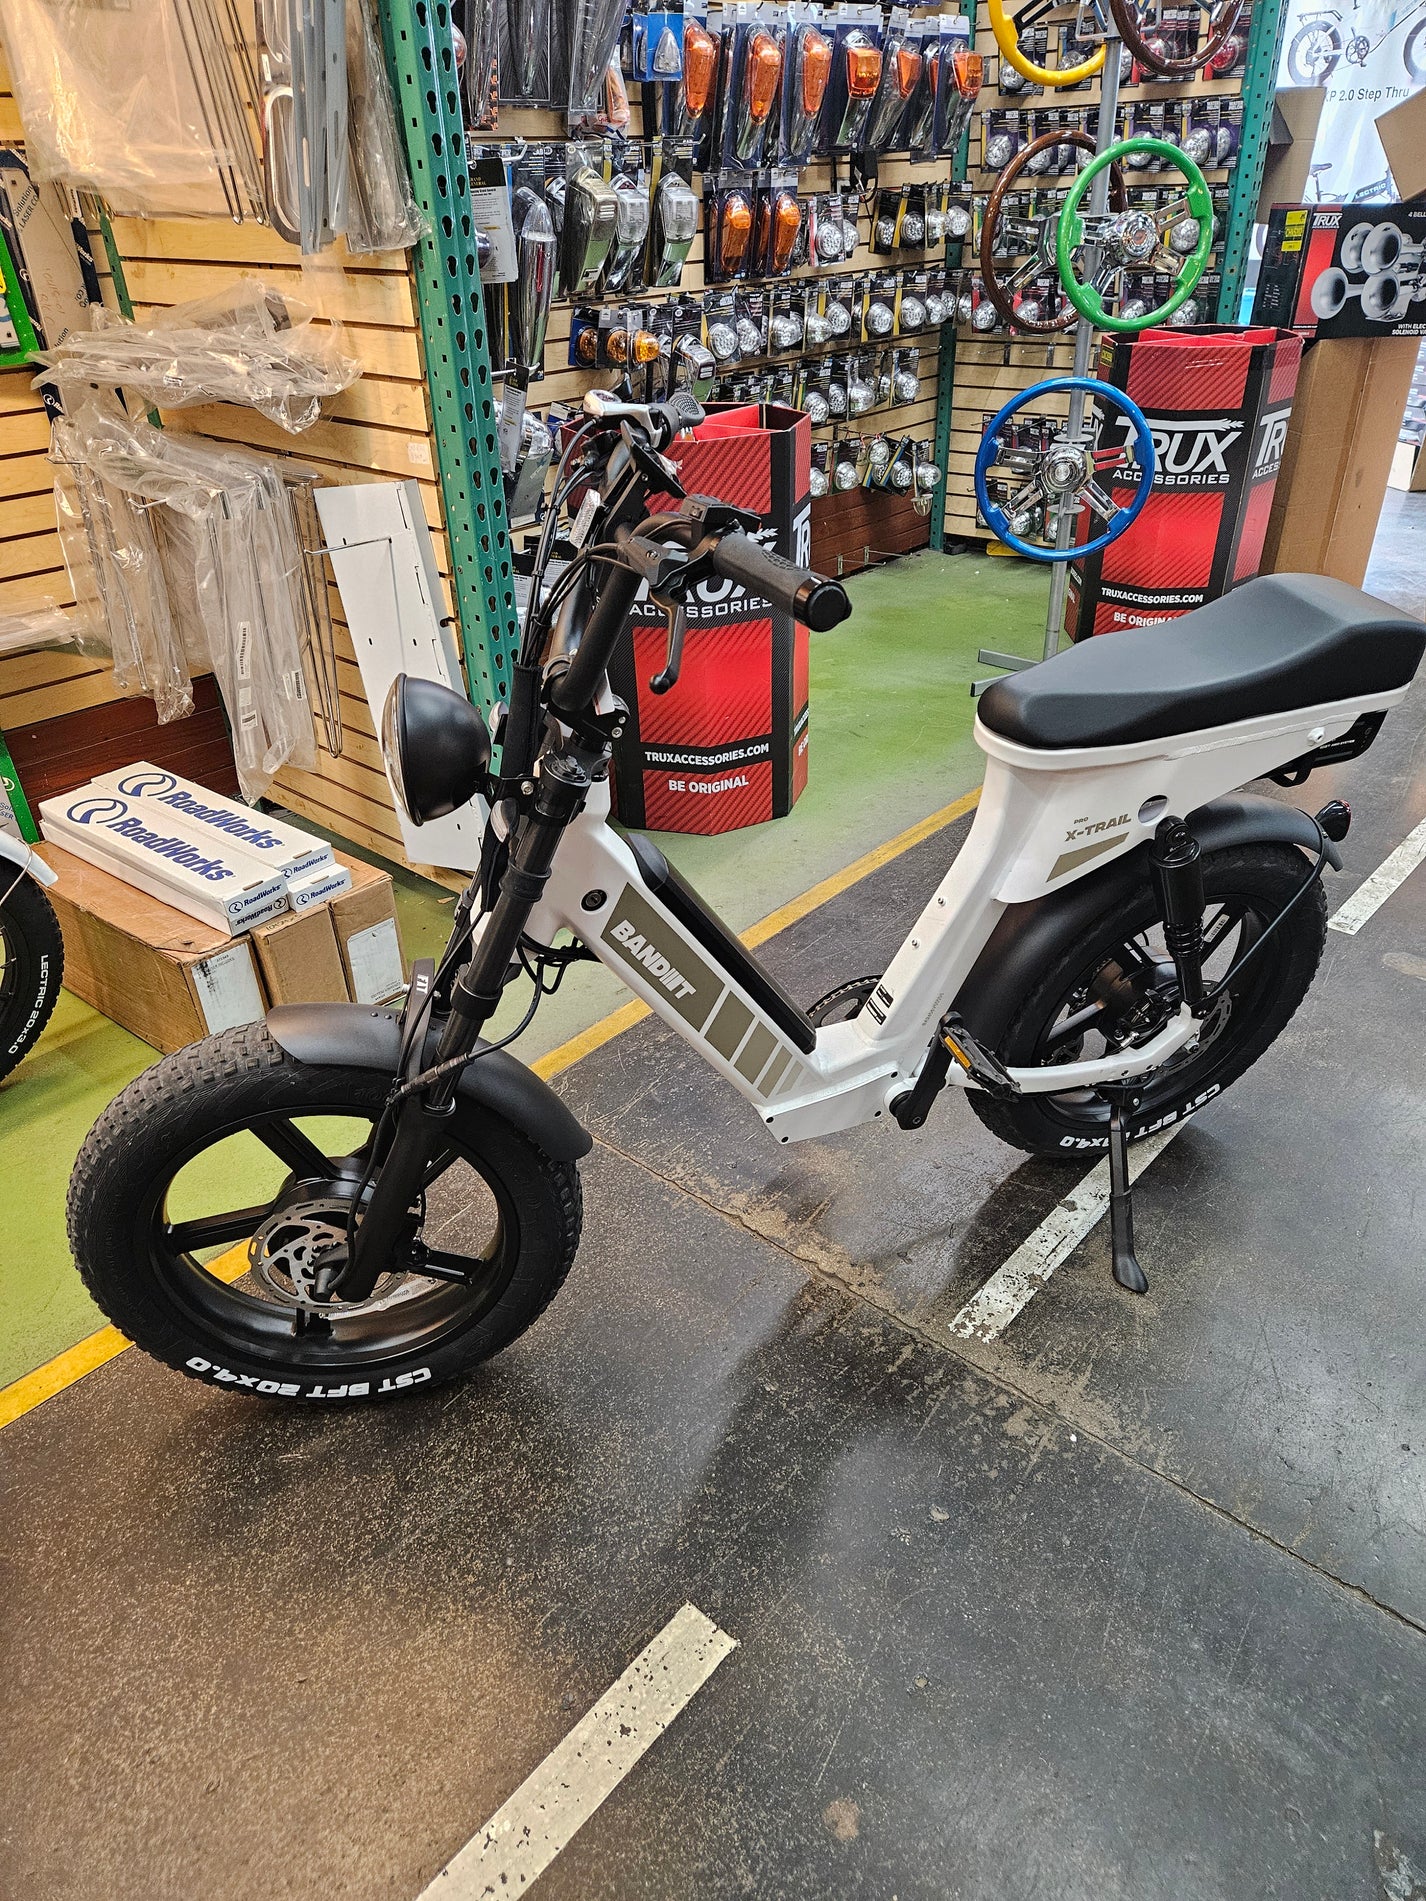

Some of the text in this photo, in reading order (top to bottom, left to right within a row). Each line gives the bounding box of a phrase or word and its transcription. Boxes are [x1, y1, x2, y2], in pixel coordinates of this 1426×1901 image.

[1339, 89, 1355, 101] 2.0
[1357, 88, 1382, 102] Step
[1385, 86, 1410, 98] Thru
[1313, 212, 1343, 226] TRUX
[1115, 416, 1245, 474] TRUX
[1255, 407, 1292, 467] TR
[1113, 470, 1230, 485] ACCSSORIES
[793, 502, 811, 569] TR
[1101, 586, 1204, 604] TRUXACCESSORIES.COM
[629, 597, 773, 618] ACSSORIES
[1113, 611, 1177, 627] BE ORIGIN
[645, 743, 770, 766] TRUXACCESSORIES.COM
[668, 775, 750, 794] BE ORIGINAL
[157, 791, 284, 849] RoadWorks
[1065, 813, 1132, 841] X-TRAIL
[106, 817, 236, 881] RoadWorks
[293, 854, 328, 874] RoadWorks
[244, 884, 282, 907] RoadWorks
[310, 879, 346, 899] RoadWorks
[35, 954, 49, 1009] LECTRIC
[1182, 1083, 1221, 1115] CST
[1134, 1110, 1178, 1138] BFT
[305, 1382, 370, 1398] BFT
[378, 1367, 432, 1393] CST
